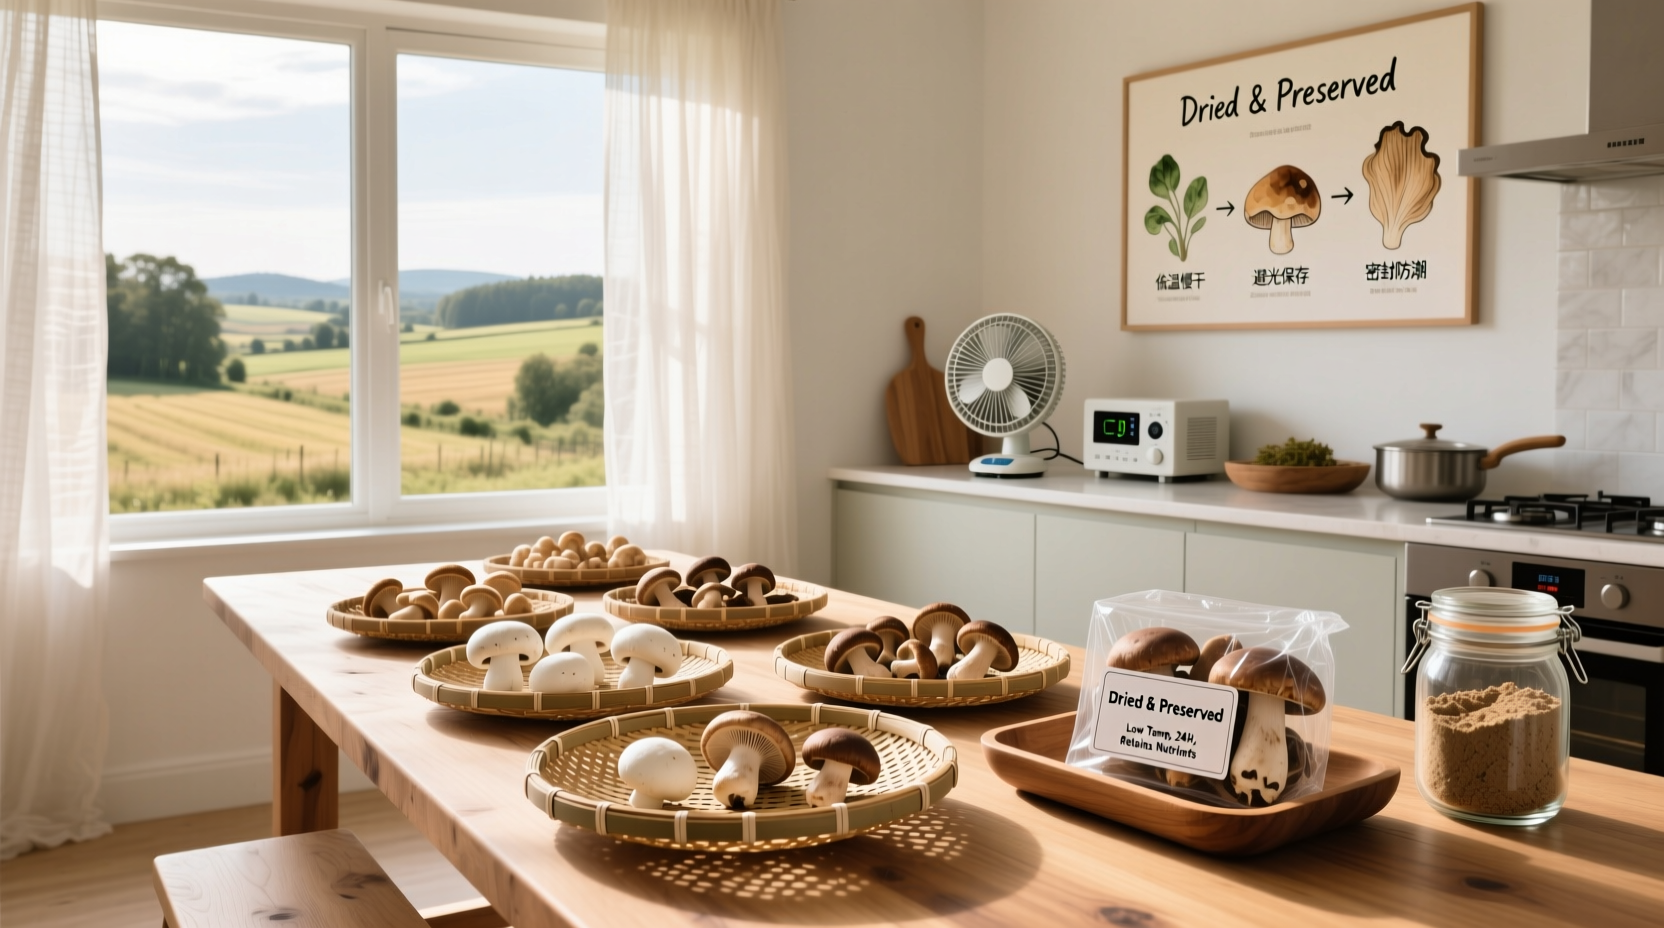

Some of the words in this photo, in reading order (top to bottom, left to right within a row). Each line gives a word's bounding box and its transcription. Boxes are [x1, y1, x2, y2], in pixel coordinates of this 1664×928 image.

[1180, 85, 1240, 127] Dried
[1248, 84, 1267, 114] &
[1277, 56, 1397, 112] Preserved
[1108, 690, 1144, 709] Dried
[1146, 696, 1155, 711] &
[1159, 698, 1224, 723] Preserved
[1126, 723, 1144, 735] Low
